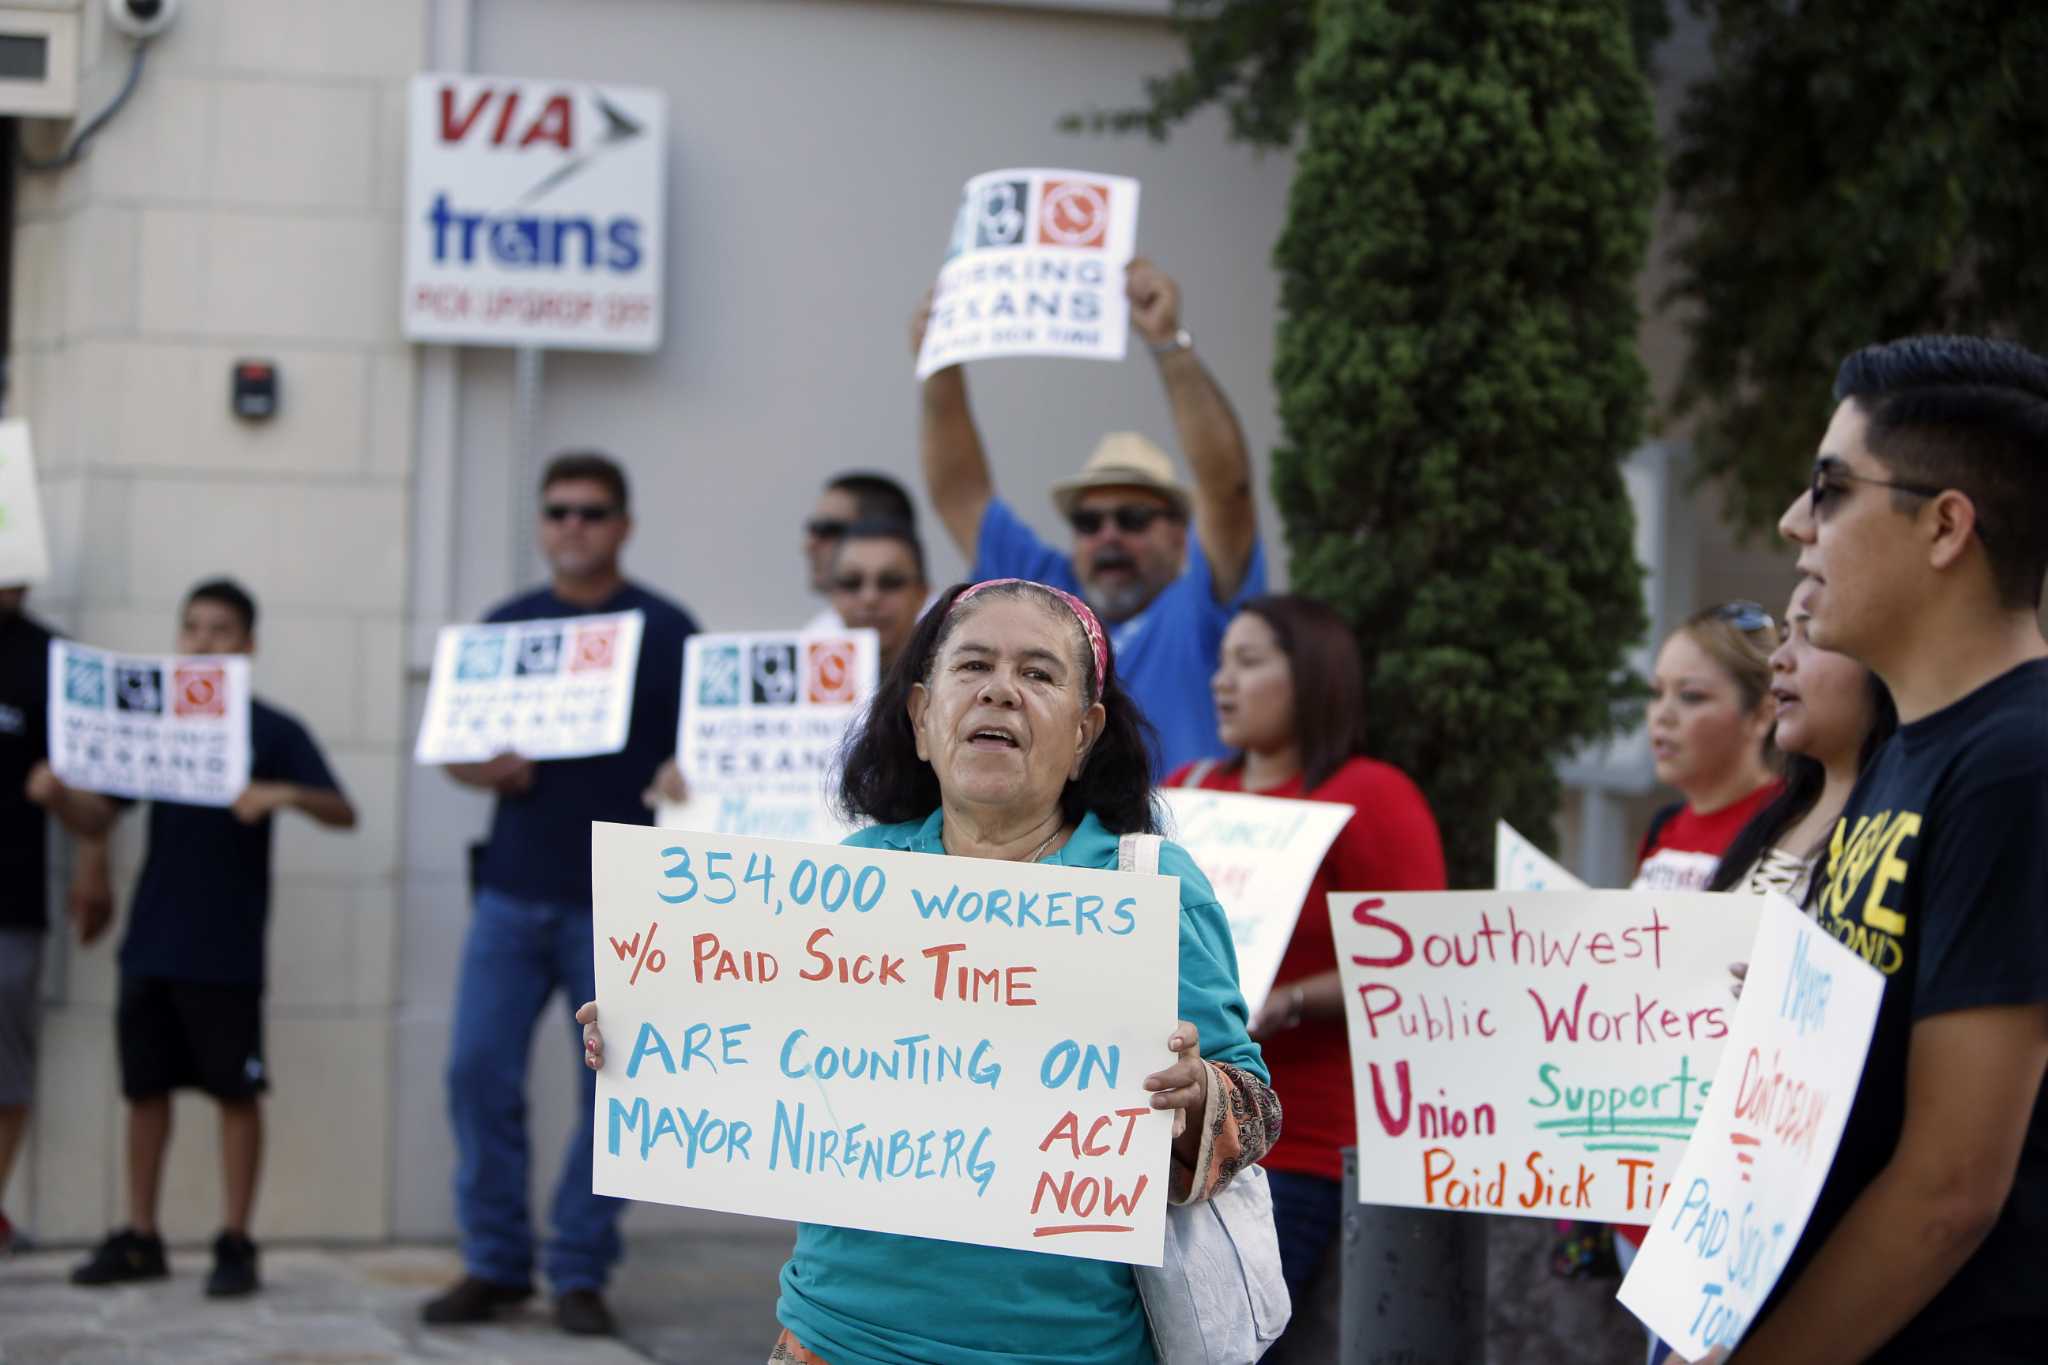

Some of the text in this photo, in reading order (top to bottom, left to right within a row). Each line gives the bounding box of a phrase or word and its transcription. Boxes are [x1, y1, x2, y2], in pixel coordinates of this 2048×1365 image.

[439, 87, 573, 150] VIA
[428, 192, 644, 273] trans
[940, 258, 1104, 293] ORKING
[696, 750, 830, 777] TEXAN
[657, 845, 1138, 936] 354,000 WORKERS
[692, 932, 779, 985] PAID
[798, 927, 906, 986] SICK
[921, 943, 1039, 1007] TIME
[1350, 896, 1670, 970] Southwest
[1356, 982, 1731, 1046] Public Workers
[626, 1022, 1121, 1091] ARE COUNTING ON
[1038, 1107, 1152, 1160] ACT
[1367, 1059, 1498, 1140] Union
[607, 1097, 997, 1198] MAYOR NIRENBERG
[1422, 1147, 1508, 1211] Paid
[1517, 1149, 1597, 1212] Sick
[1030, 1170, 1149, 1218] NOW
[1671, 1176, 1731, 1260] PAID
